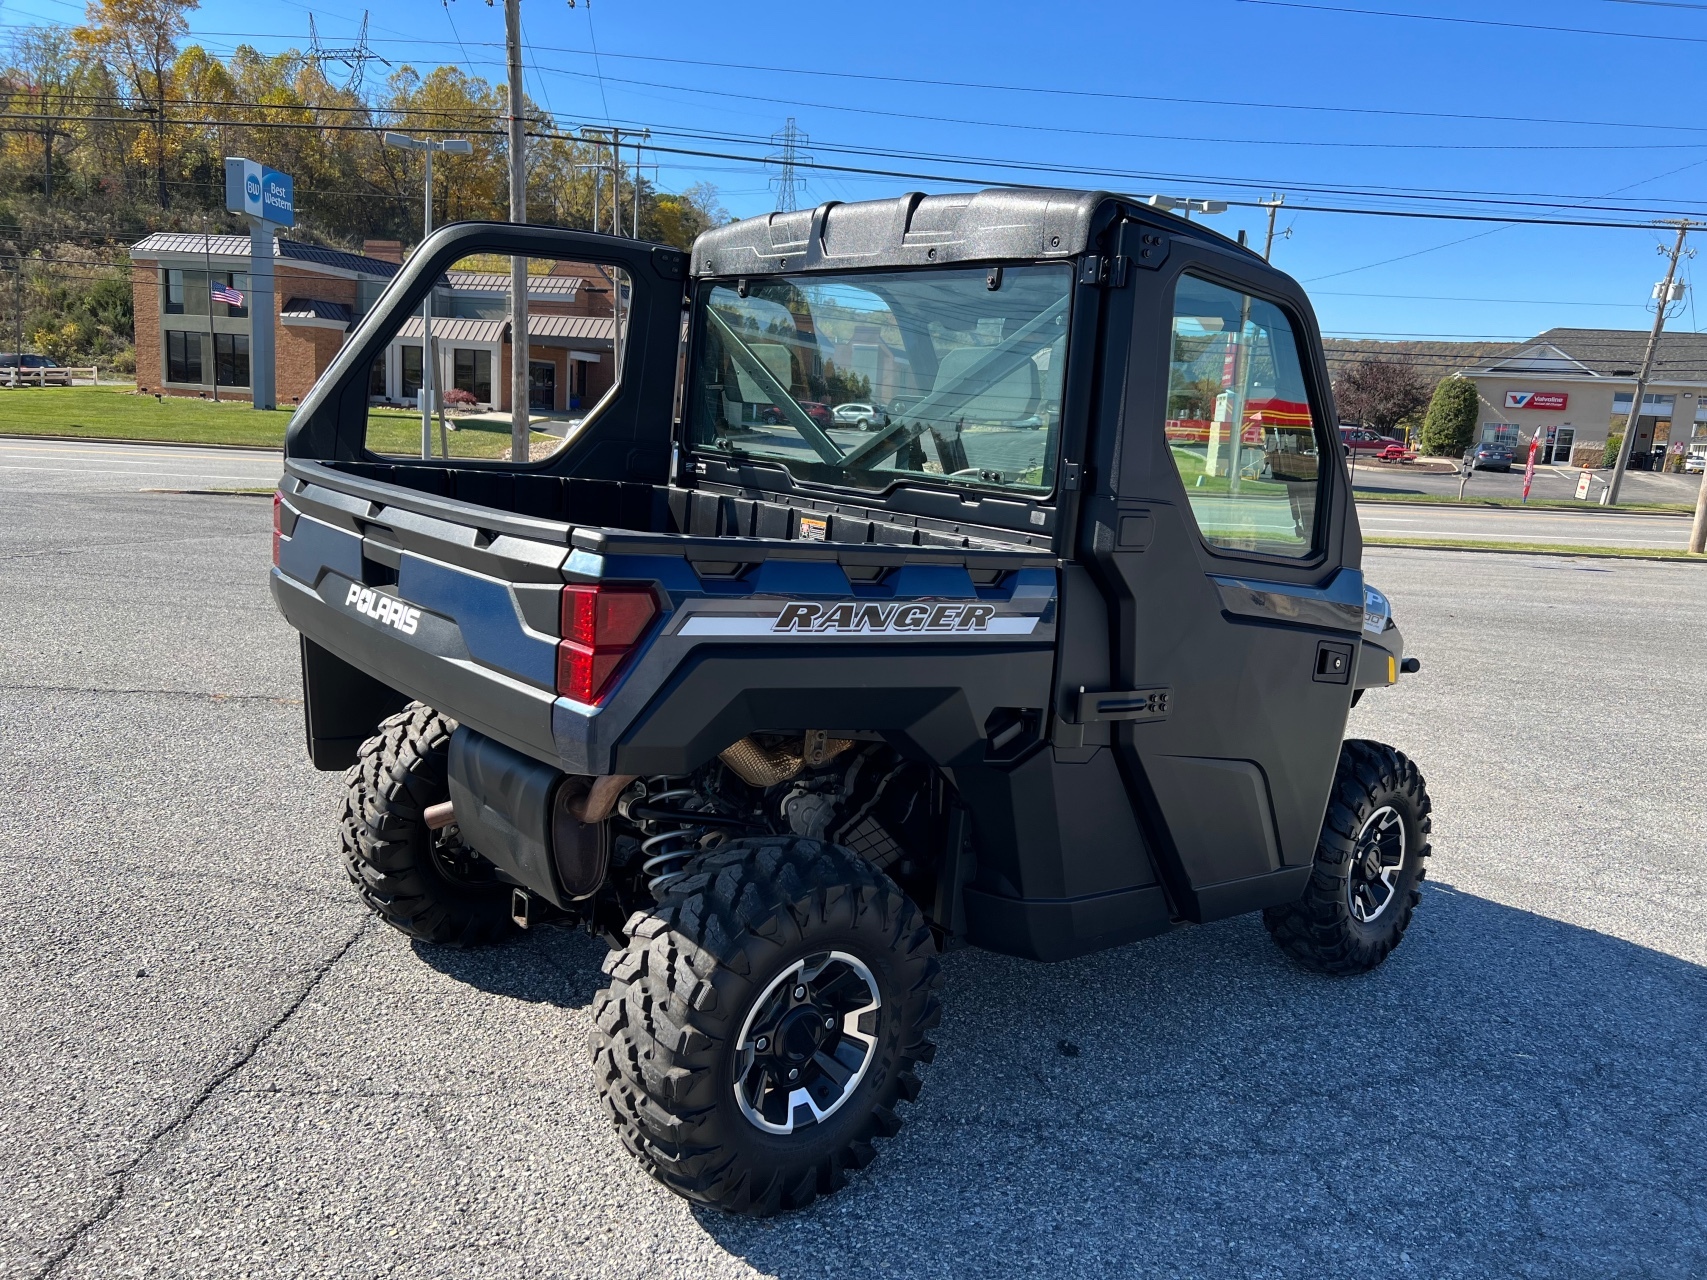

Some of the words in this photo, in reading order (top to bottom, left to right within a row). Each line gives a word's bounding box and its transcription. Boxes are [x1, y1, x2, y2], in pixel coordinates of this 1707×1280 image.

[247, 181, 260, 196] BW
[270, 182, 286, 198] Best
[264, 192, 292, 211] Western
[345, 583, 421, 635] POLARIS
[771, 601, 996, 632] RANGER
